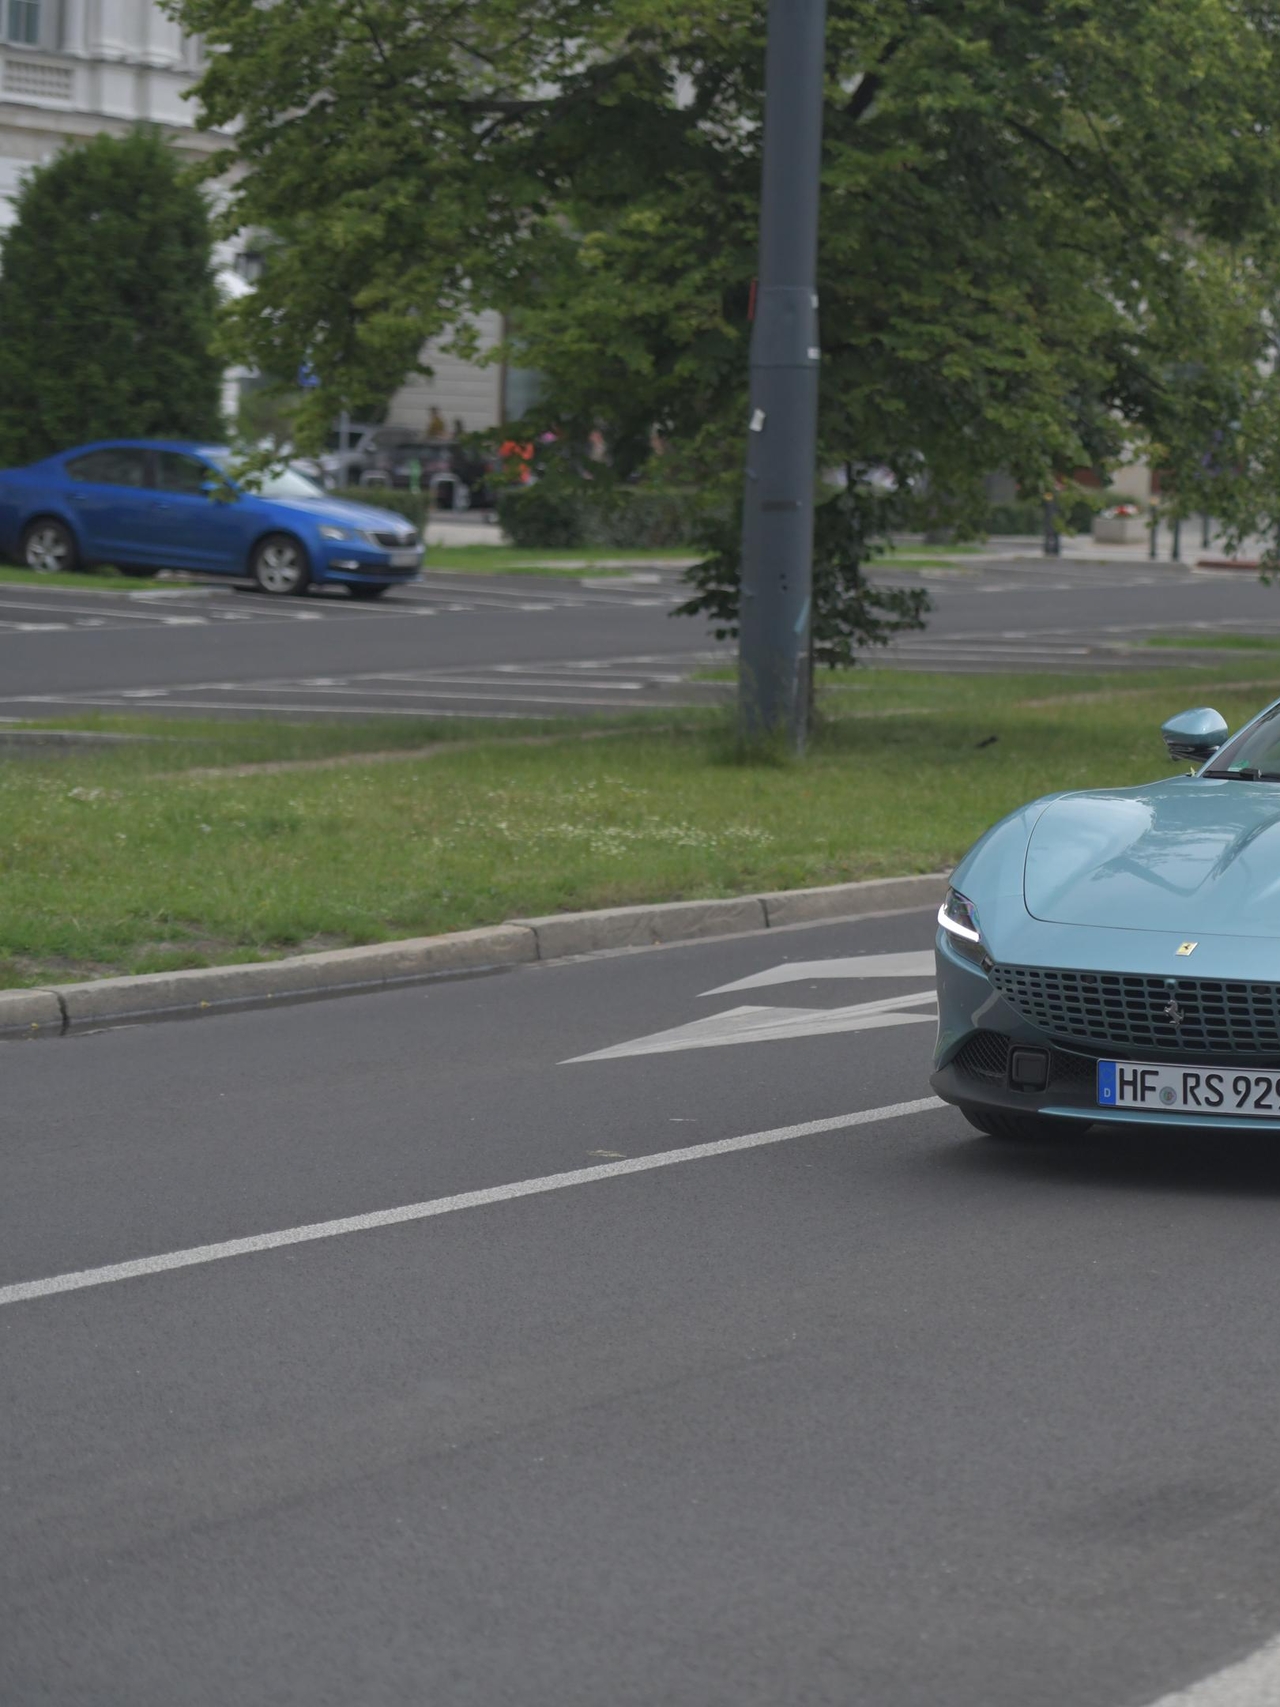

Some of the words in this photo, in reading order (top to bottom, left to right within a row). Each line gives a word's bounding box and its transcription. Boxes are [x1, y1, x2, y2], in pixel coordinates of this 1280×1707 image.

[1103, 1087, 1111, 1097] D
[1119, 1068, 1159, 1102] HF
[1182, 1072, 1224, 1107] RS
